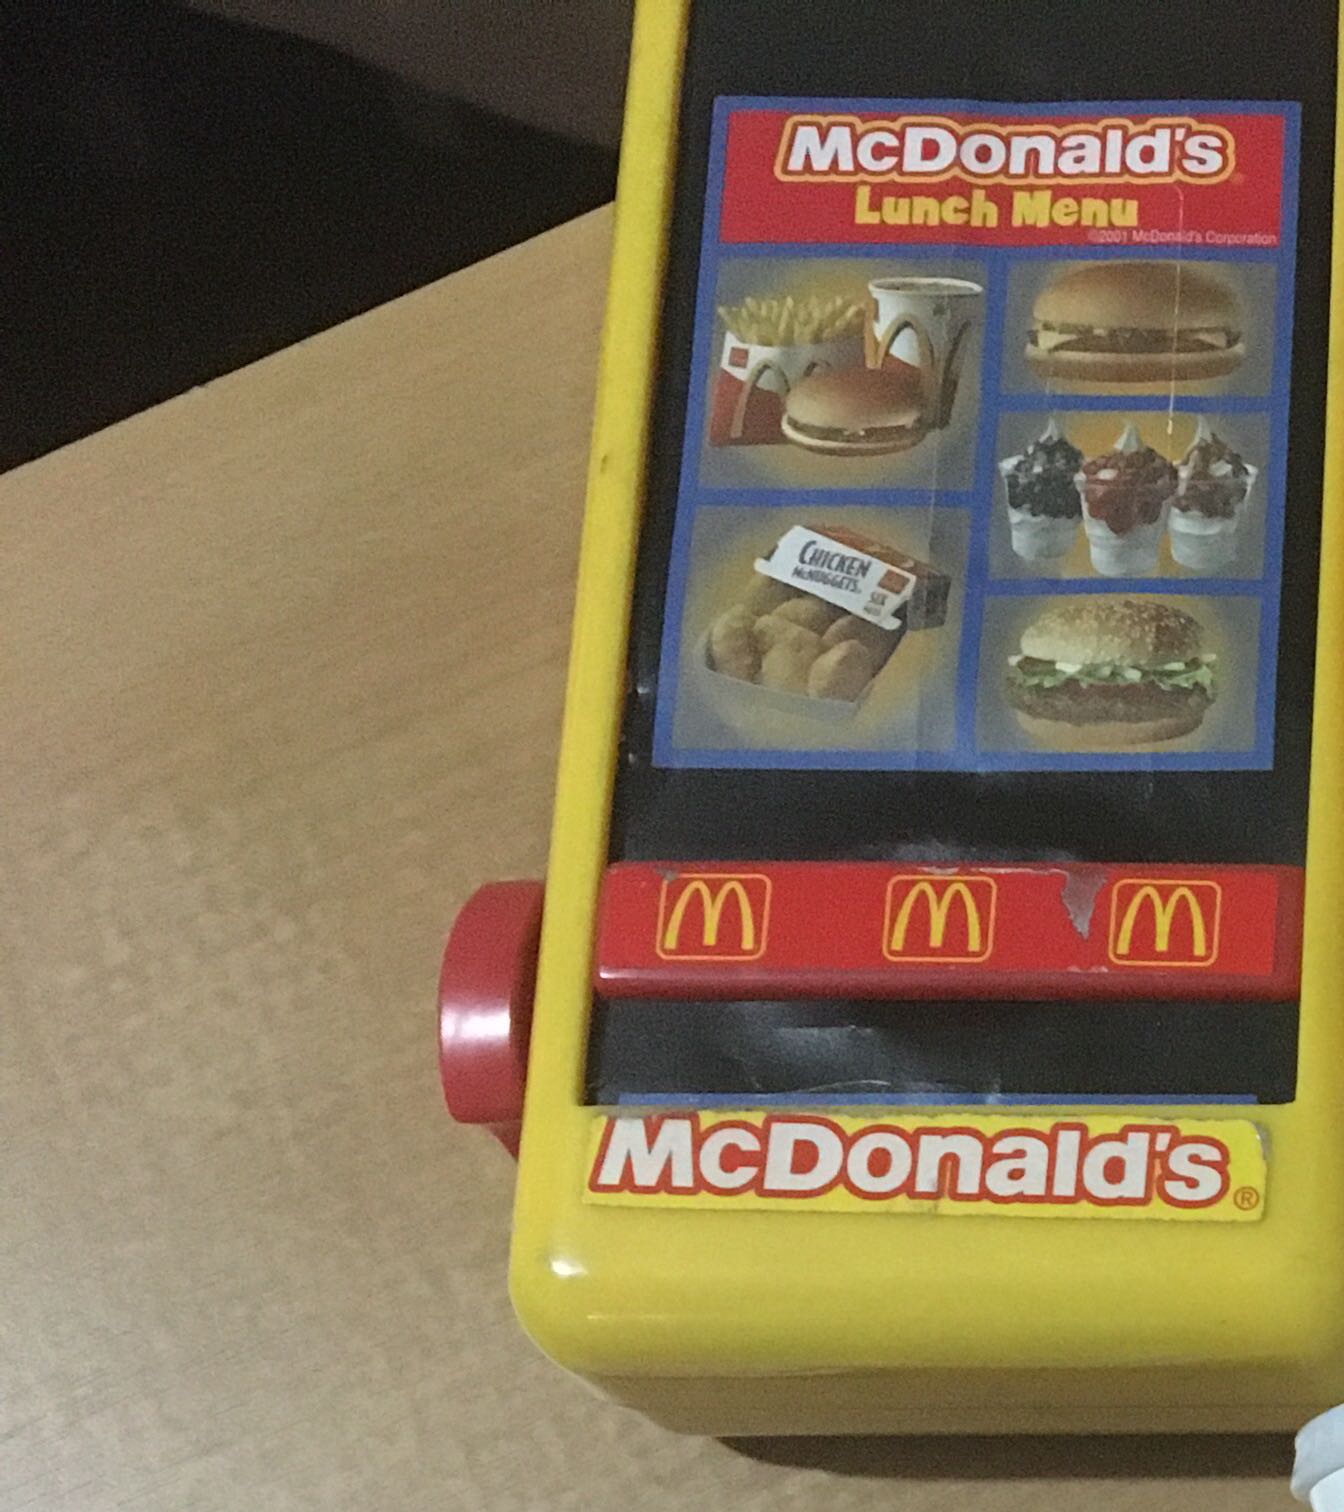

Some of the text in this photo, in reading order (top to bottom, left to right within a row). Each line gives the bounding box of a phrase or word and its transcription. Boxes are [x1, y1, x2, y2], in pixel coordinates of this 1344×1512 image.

[784, 124, 1225, 175] McDonald's
[854, 184, 1139, 228] Lunch Menu
[1131, 229, 1201, 244] McDonald's
[1205, 230, 1277, 246] Corporation
[798, 540, 872, 579] CHICKEN
[595, 1114, 1224, 1202] McDonald's
